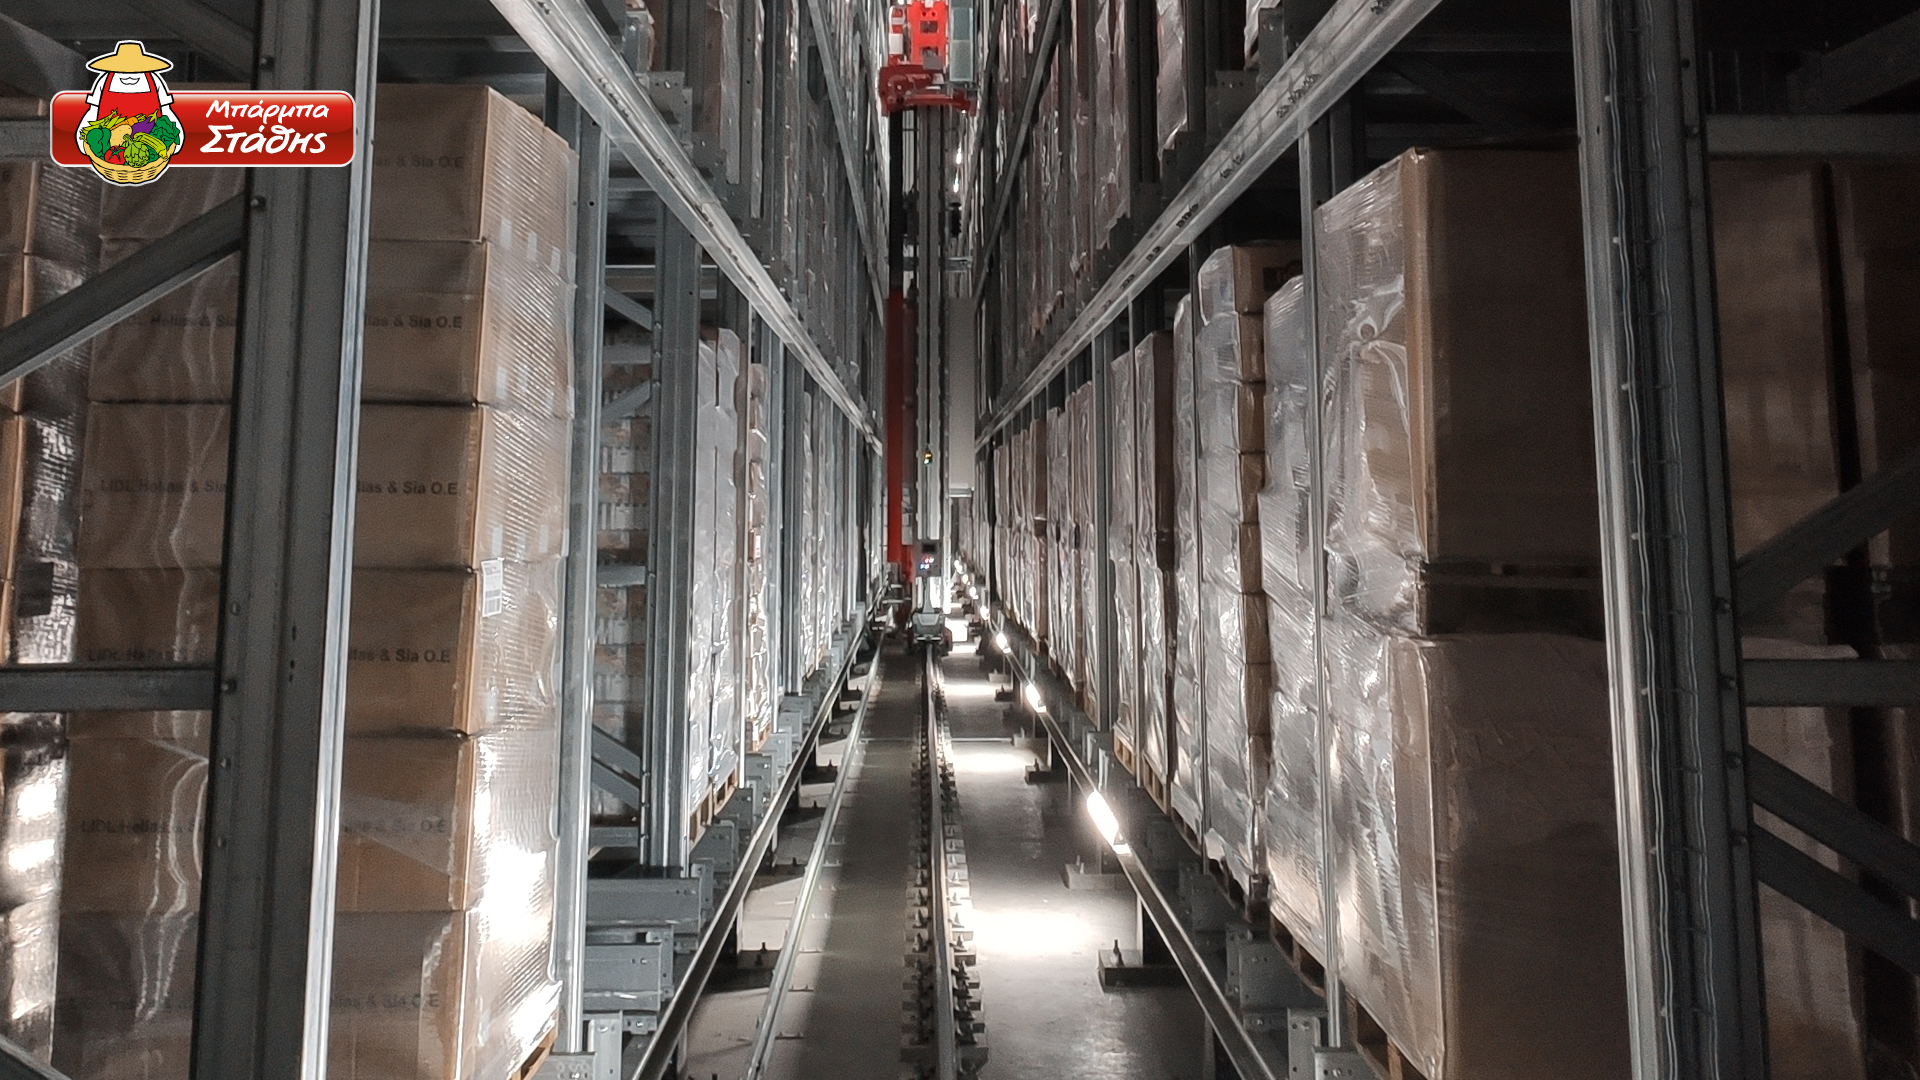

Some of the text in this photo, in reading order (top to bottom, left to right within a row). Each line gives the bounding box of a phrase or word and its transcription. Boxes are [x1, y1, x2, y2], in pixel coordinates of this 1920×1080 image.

[394, 315, 404, 328] &
[409, 316, 432, 329] Sia
[436, 316, 463, 329] O.E
[387, 480, 398, 494] &
[402, 481, 427, 495] Sia
[430, 481, 458, 495] O.E
[380, 647, 391, 662] &
[395, 648, 420, 662] Sia
[424, 648, 450, 663] O.E
